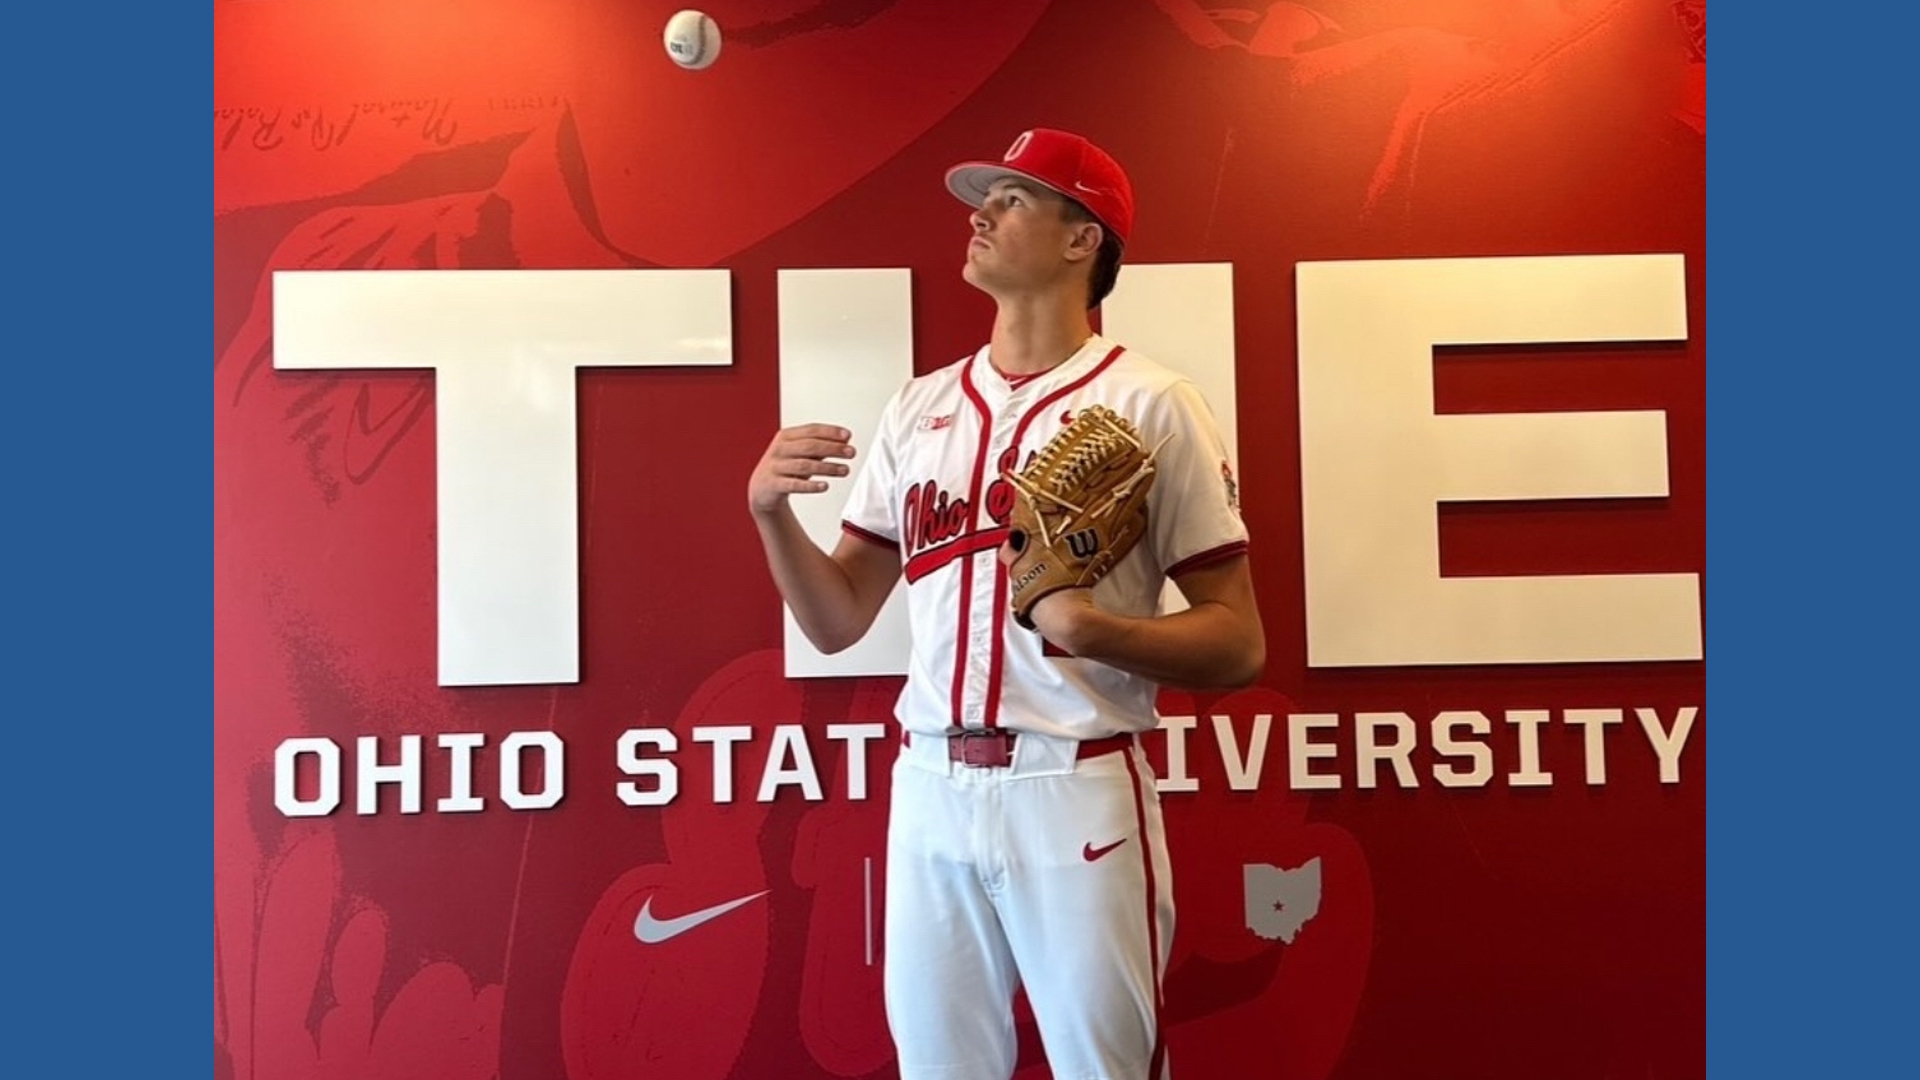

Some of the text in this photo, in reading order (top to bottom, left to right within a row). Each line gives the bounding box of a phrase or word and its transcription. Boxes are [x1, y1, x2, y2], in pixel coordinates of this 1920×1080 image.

[1004, 130, 1034, 162] O
[904, 479, 970, 557] Ohio
[1065, 528, 1099, 559] W
[1011, 562, 1048, 594] ilson
[274, 706, 1699, 816] OHIO STAT IVERSITY
